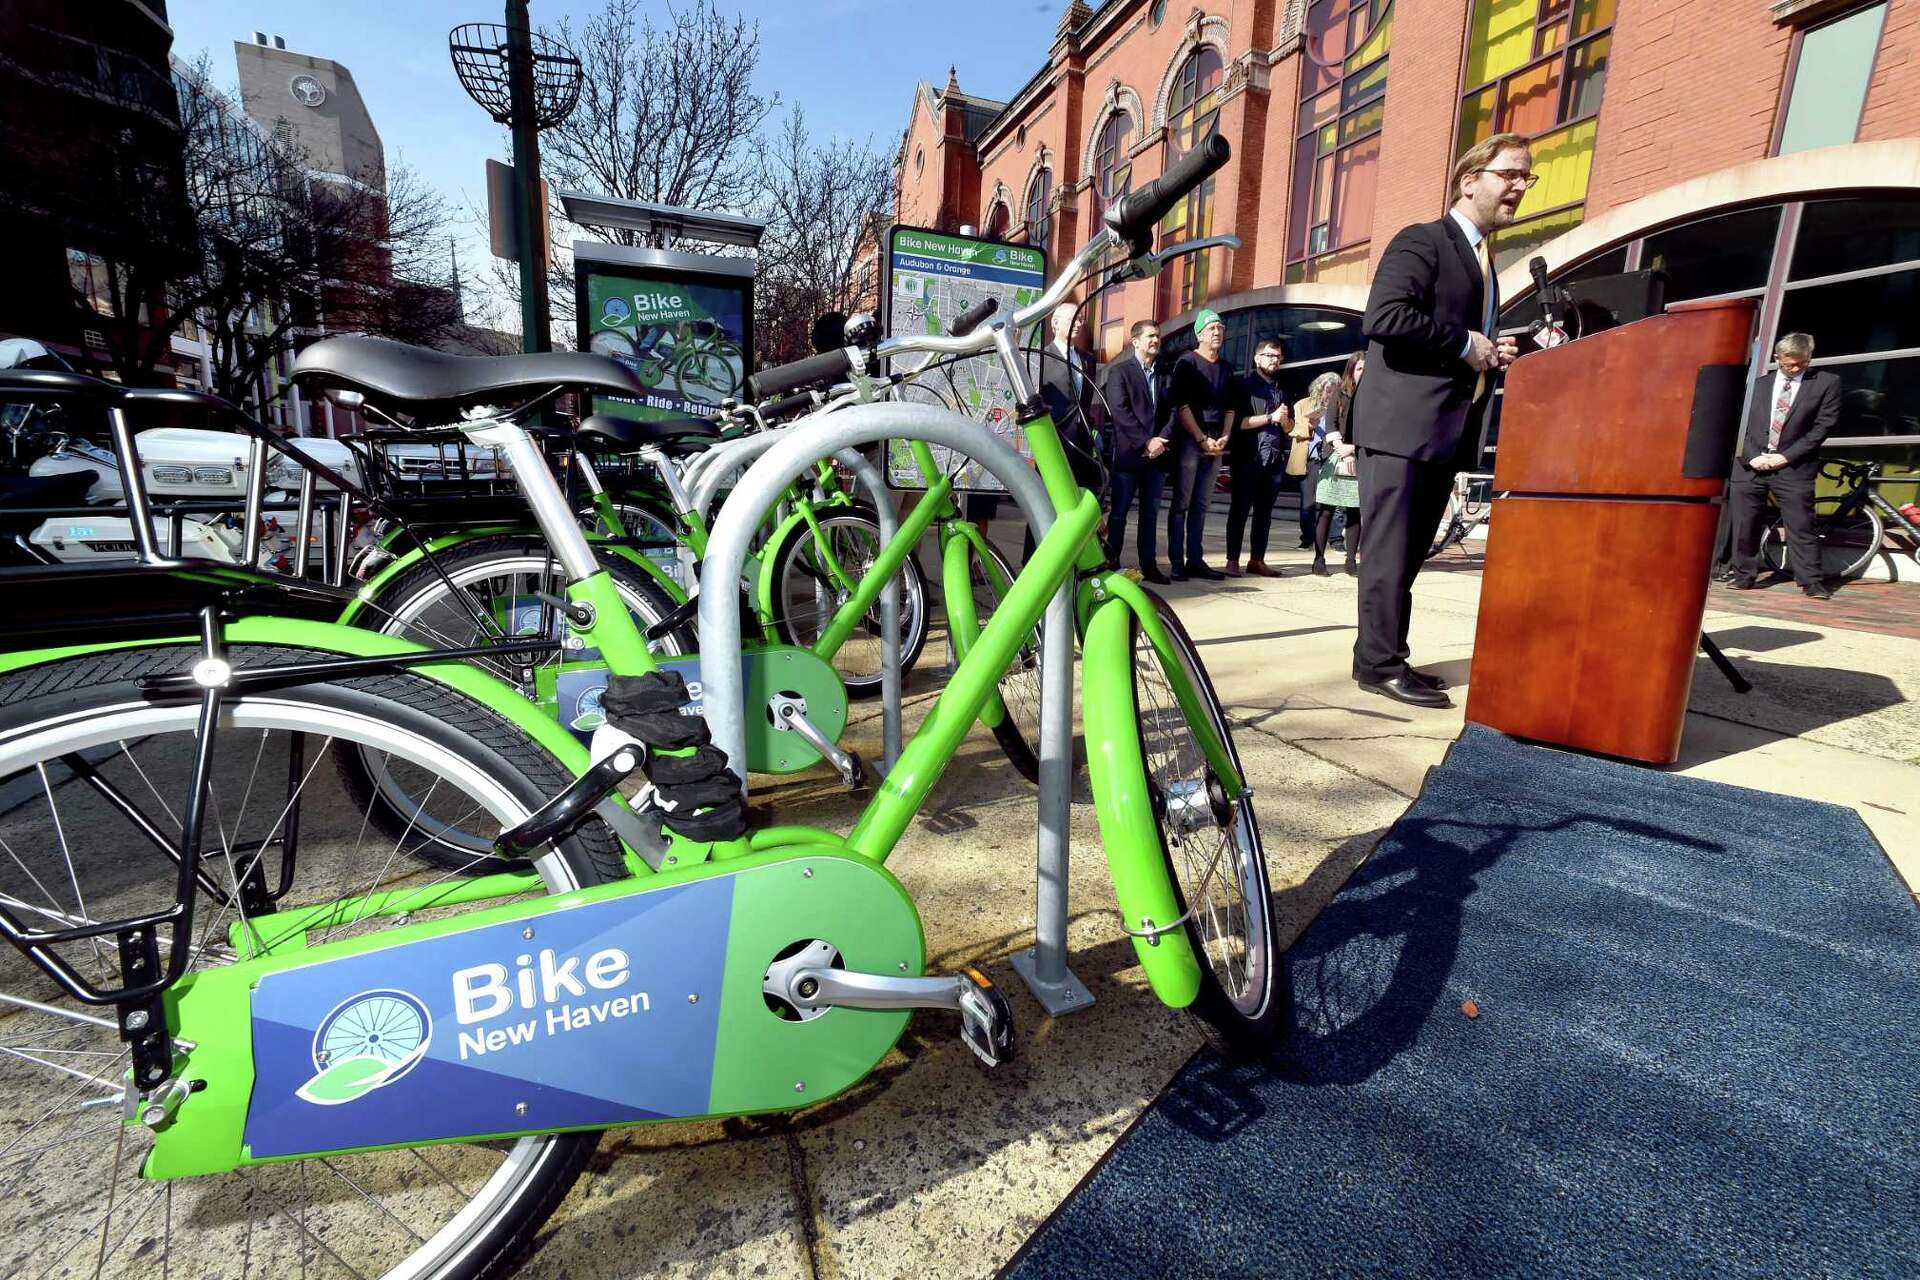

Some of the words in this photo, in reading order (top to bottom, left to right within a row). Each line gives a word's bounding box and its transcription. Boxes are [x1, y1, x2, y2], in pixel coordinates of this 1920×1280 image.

[899, 236, 922, 249] Bike
[924, 240, 946, 252] New
[948, 243, 978, 257] Haven
[1010, 250, 1033, 263] Bike
[900, 258, 934, 270] Audubon
[936, 262, 943, 271] &
[943, 264, 972, 276] Orange
[633, 292, 682, 311] Bike
[637, 312, 659, 321] New
[659, 309, 690, 319] Haven
[646, 395, 673, 410] Ride
[94, 543, 137, 552] POLIC
[452, 947, 630, 1025] Bike
[458, 1018, 538, 1060] New
[545, 991, 650, 1036] Haven
